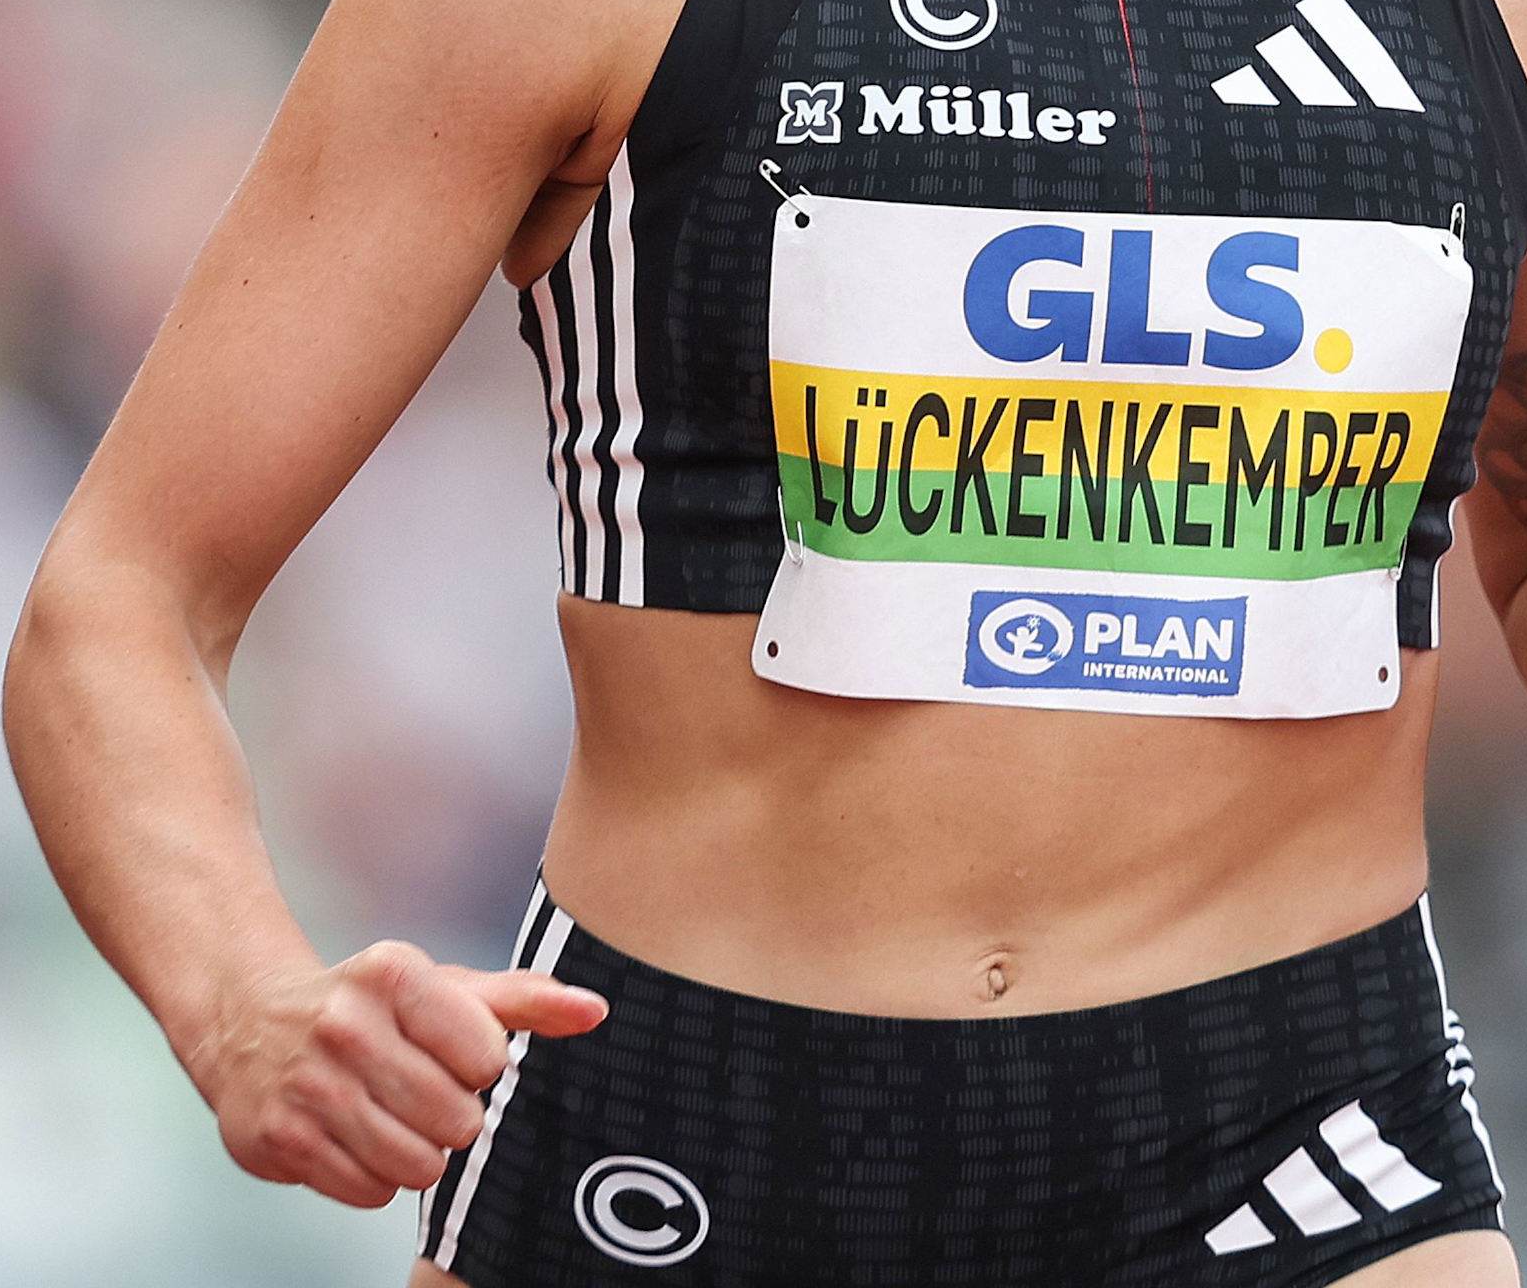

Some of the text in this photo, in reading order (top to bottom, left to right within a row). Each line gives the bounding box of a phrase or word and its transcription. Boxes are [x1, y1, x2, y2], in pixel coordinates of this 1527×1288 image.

[857, 83, 1118, 146] Müller
[804, 383, 1413, 552] LÜCKENKEMPER
[1083, 612, 1235, 663] PLAN
[1082, 661, 1230, 684] INTERNATIONAL
